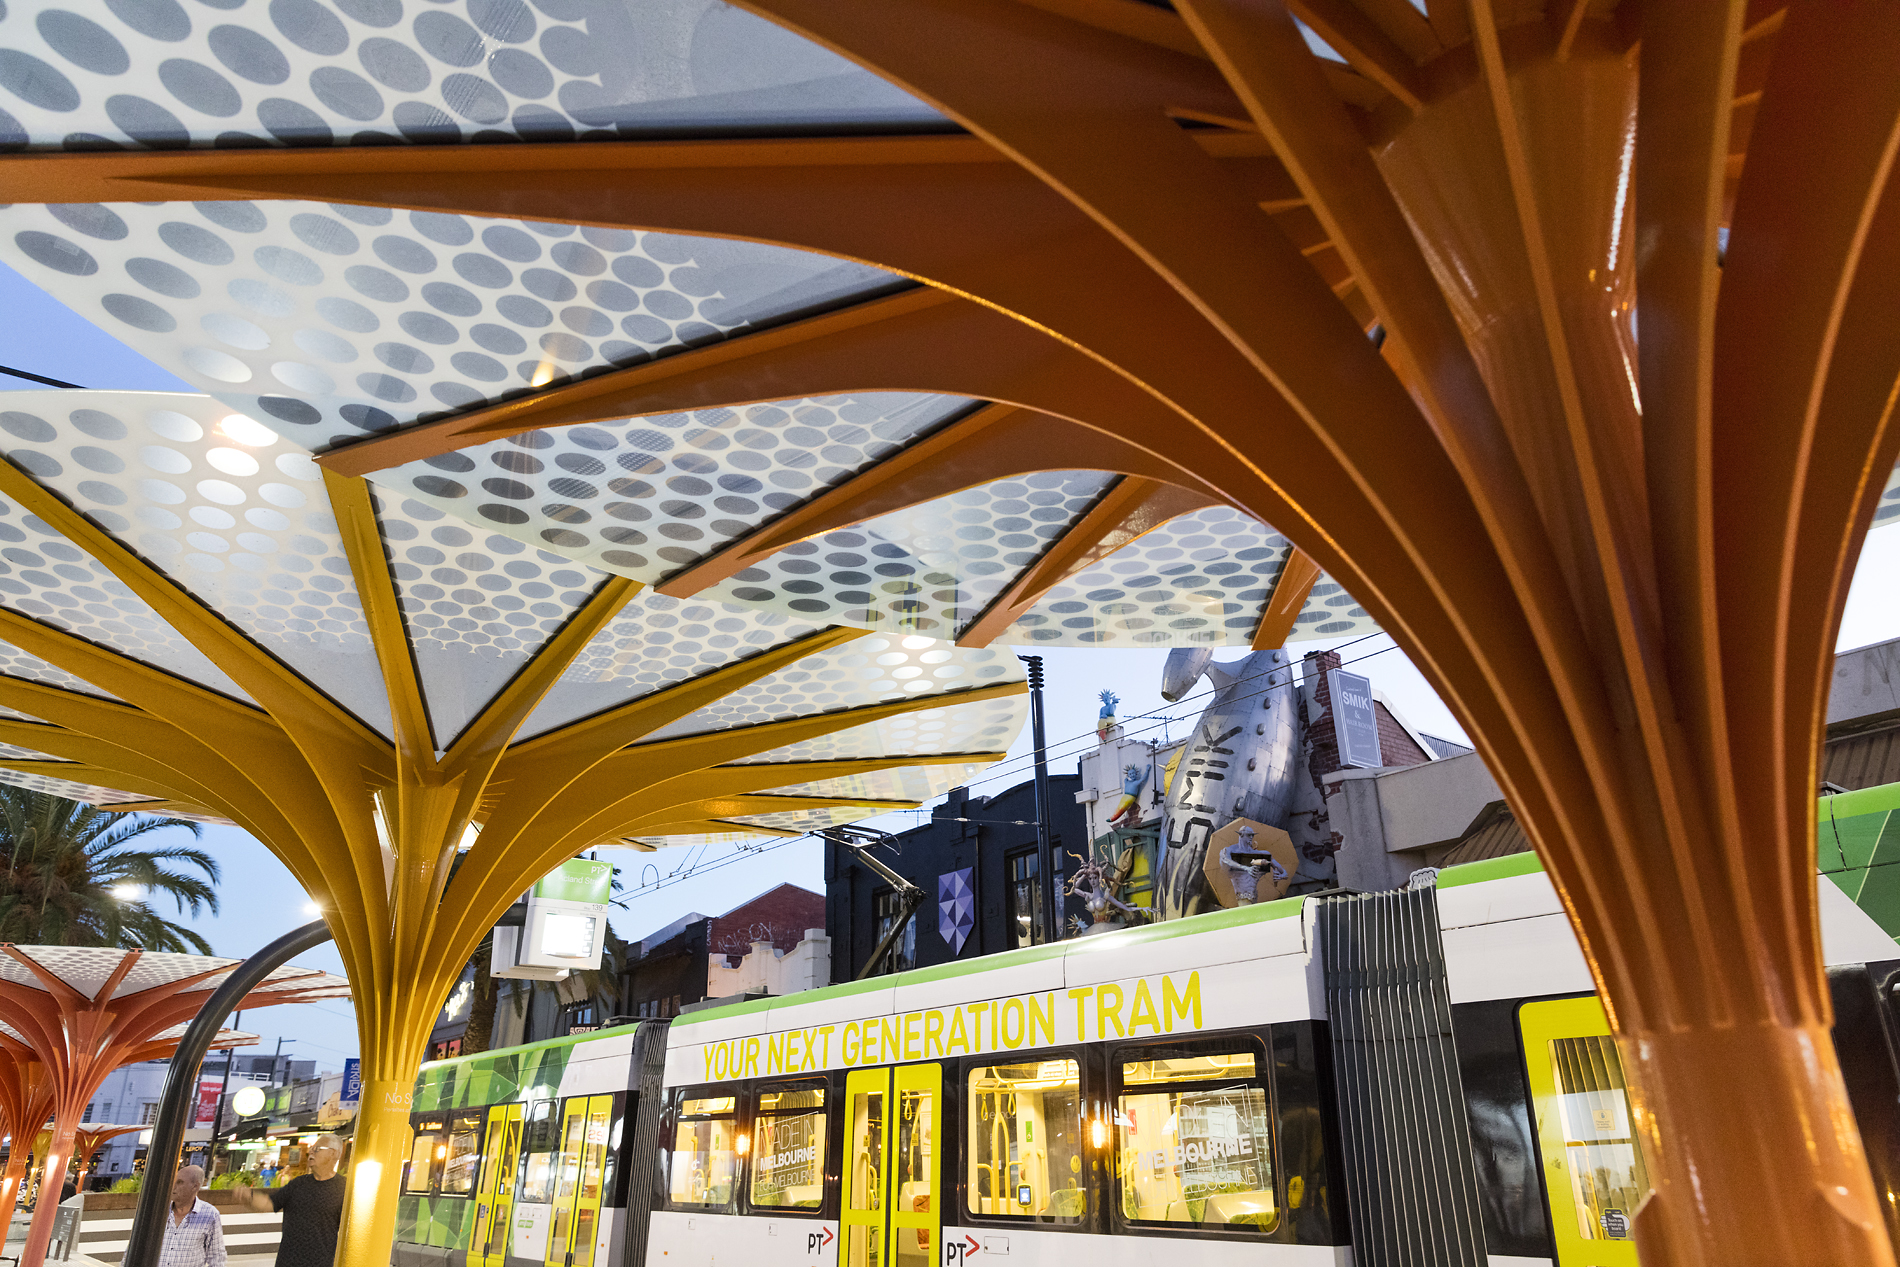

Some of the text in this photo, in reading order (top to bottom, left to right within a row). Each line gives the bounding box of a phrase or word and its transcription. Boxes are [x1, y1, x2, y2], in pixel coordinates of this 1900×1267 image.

[1342, 691, 1370, 711] SMIK
[1167, 724, 1243, 850] SMIK
[591, 866, 601, 874] PT
[703, 971, 1203, 1082] YOUR NEXT GENERATION TRAM
[384, 1092, 402, 1105] No
[760, 1119, 816, 1153] MADE IN
[760, 1146, 816, 1171] MELBOURNE
[1137, 1133, 1253, 1172] MELBOURNE
[774, 1168, 816, 1189] MELBOURNE
[807, 1233, 824, 1255] PT
[947, 1242, 967, 1267] PT
